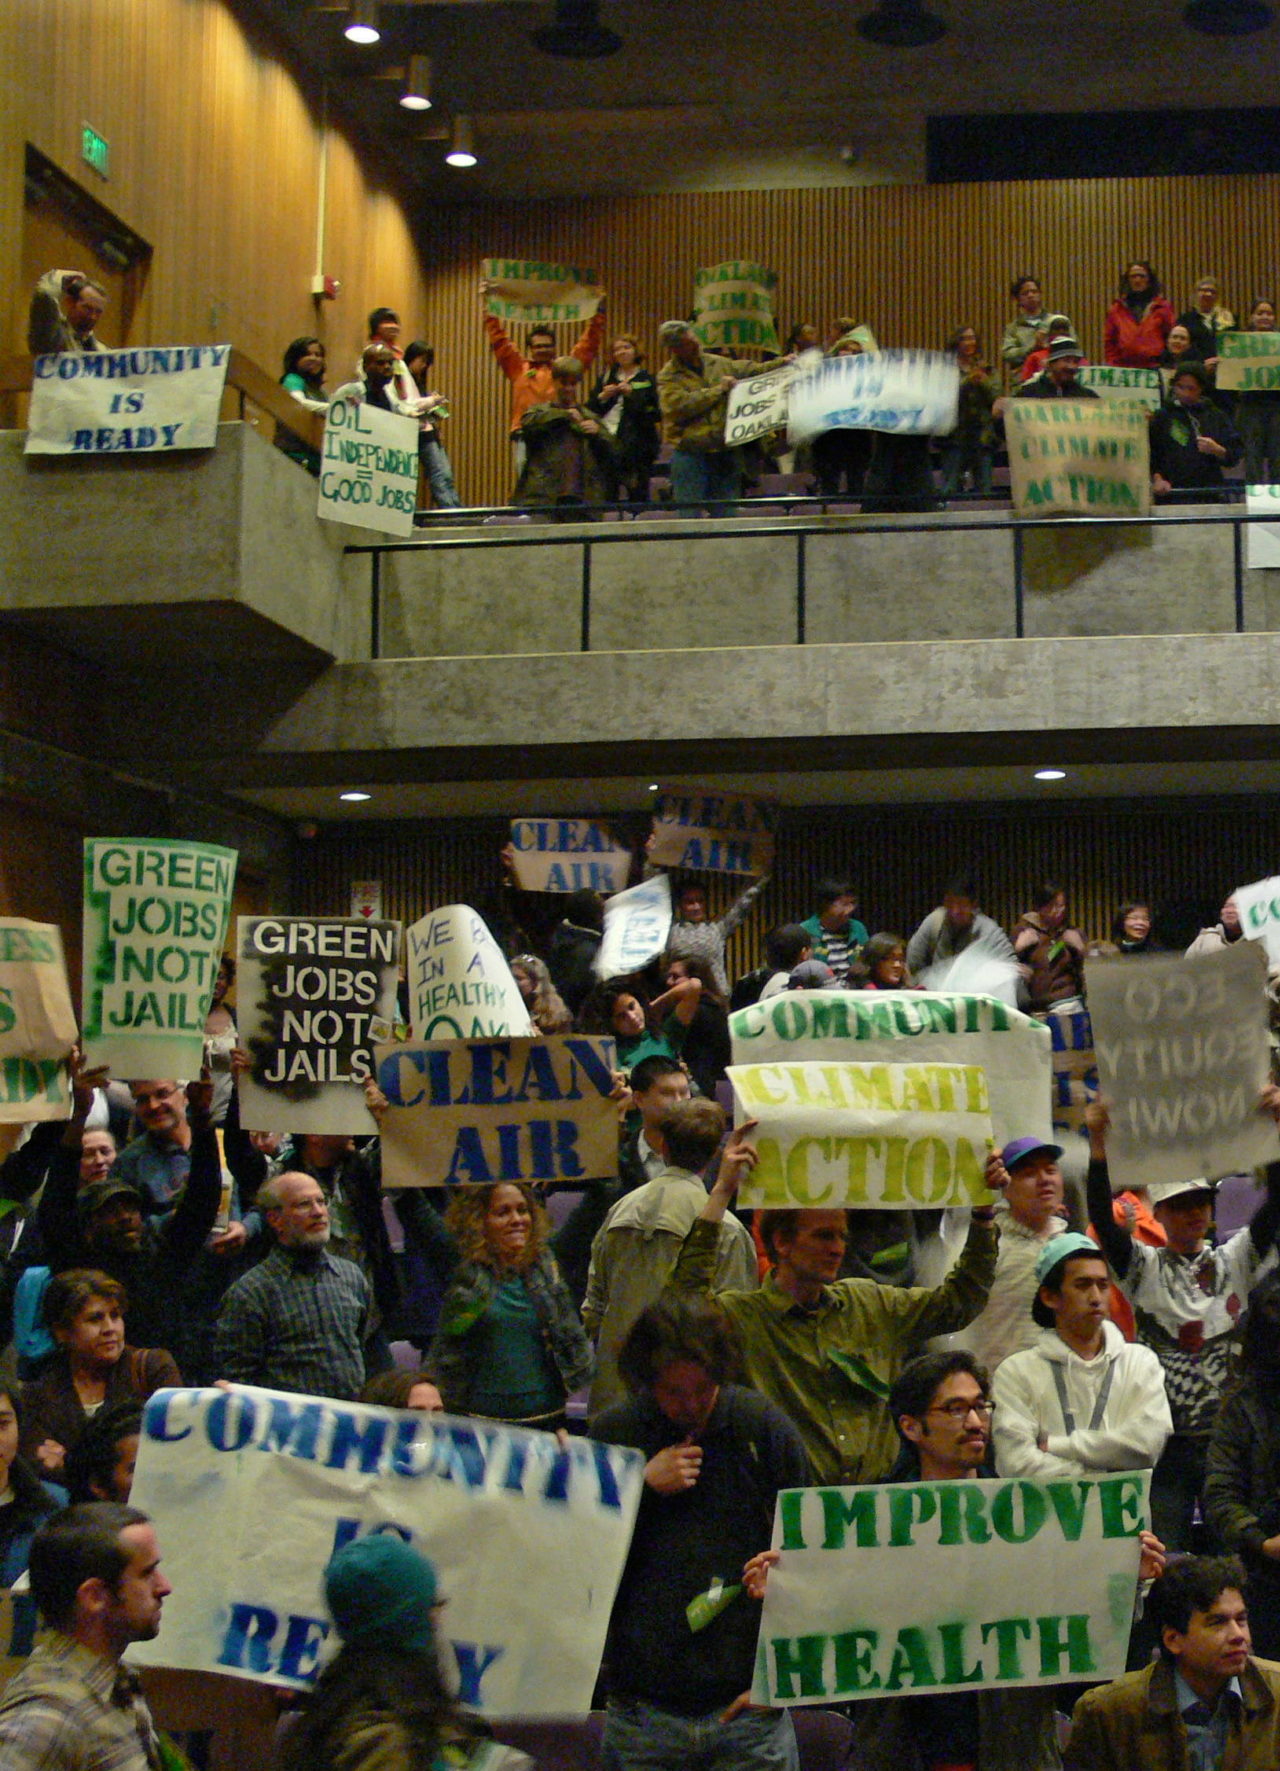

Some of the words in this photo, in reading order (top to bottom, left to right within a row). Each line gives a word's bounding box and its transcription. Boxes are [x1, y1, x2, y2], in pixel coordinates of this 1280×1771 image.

[35, 347, 226, 379] COMMUNITY
[1077, 367, 1159, 388] LIMATE
[109, 392, 145, 413] IS
[72, 423, 183, 450] READY
[321, 472, 372, 503] GOOD
[376, 485, 416, 513] JOBS
[511, 821, 615, 852] CLEA
[680, 838, 752, 871] AIR
[100, 848, 230, 897] GREEN
[545, 863, 614, 891] AIR
[112, 897, 217, 941] JOBS
[411, 918, 454, 957] WE
[253, 921, 393, 962] GREEN
[121, 945, 211, 987] NOT
[273, 965, 378, 1005] JOBS
[418, 956, 444, 988] IN
[467, 952, 485, 978] A
[418, 981, 507, 1023] HEALTHY
[734, 996, 1048, 1040] COMMUNIT
[283, 1010, 372, 1046] NOT
[265, 1049, 371, 1083] JAILS
[379, 1038, 616, 1107] CLEAN
[743, 1064, 990, 1115] CLIMATE
[445, 1120, 585, 1183] AIR
[742, 1137, 998, 1206] ACTION
[144, 1388, 645, 1510] COMMUNITY
[778, 1476, 1145, 1552] IMPROVE
[217, 1601, 504, 1708] REY
[770, 1613, 1098, 1700] HEALTH
